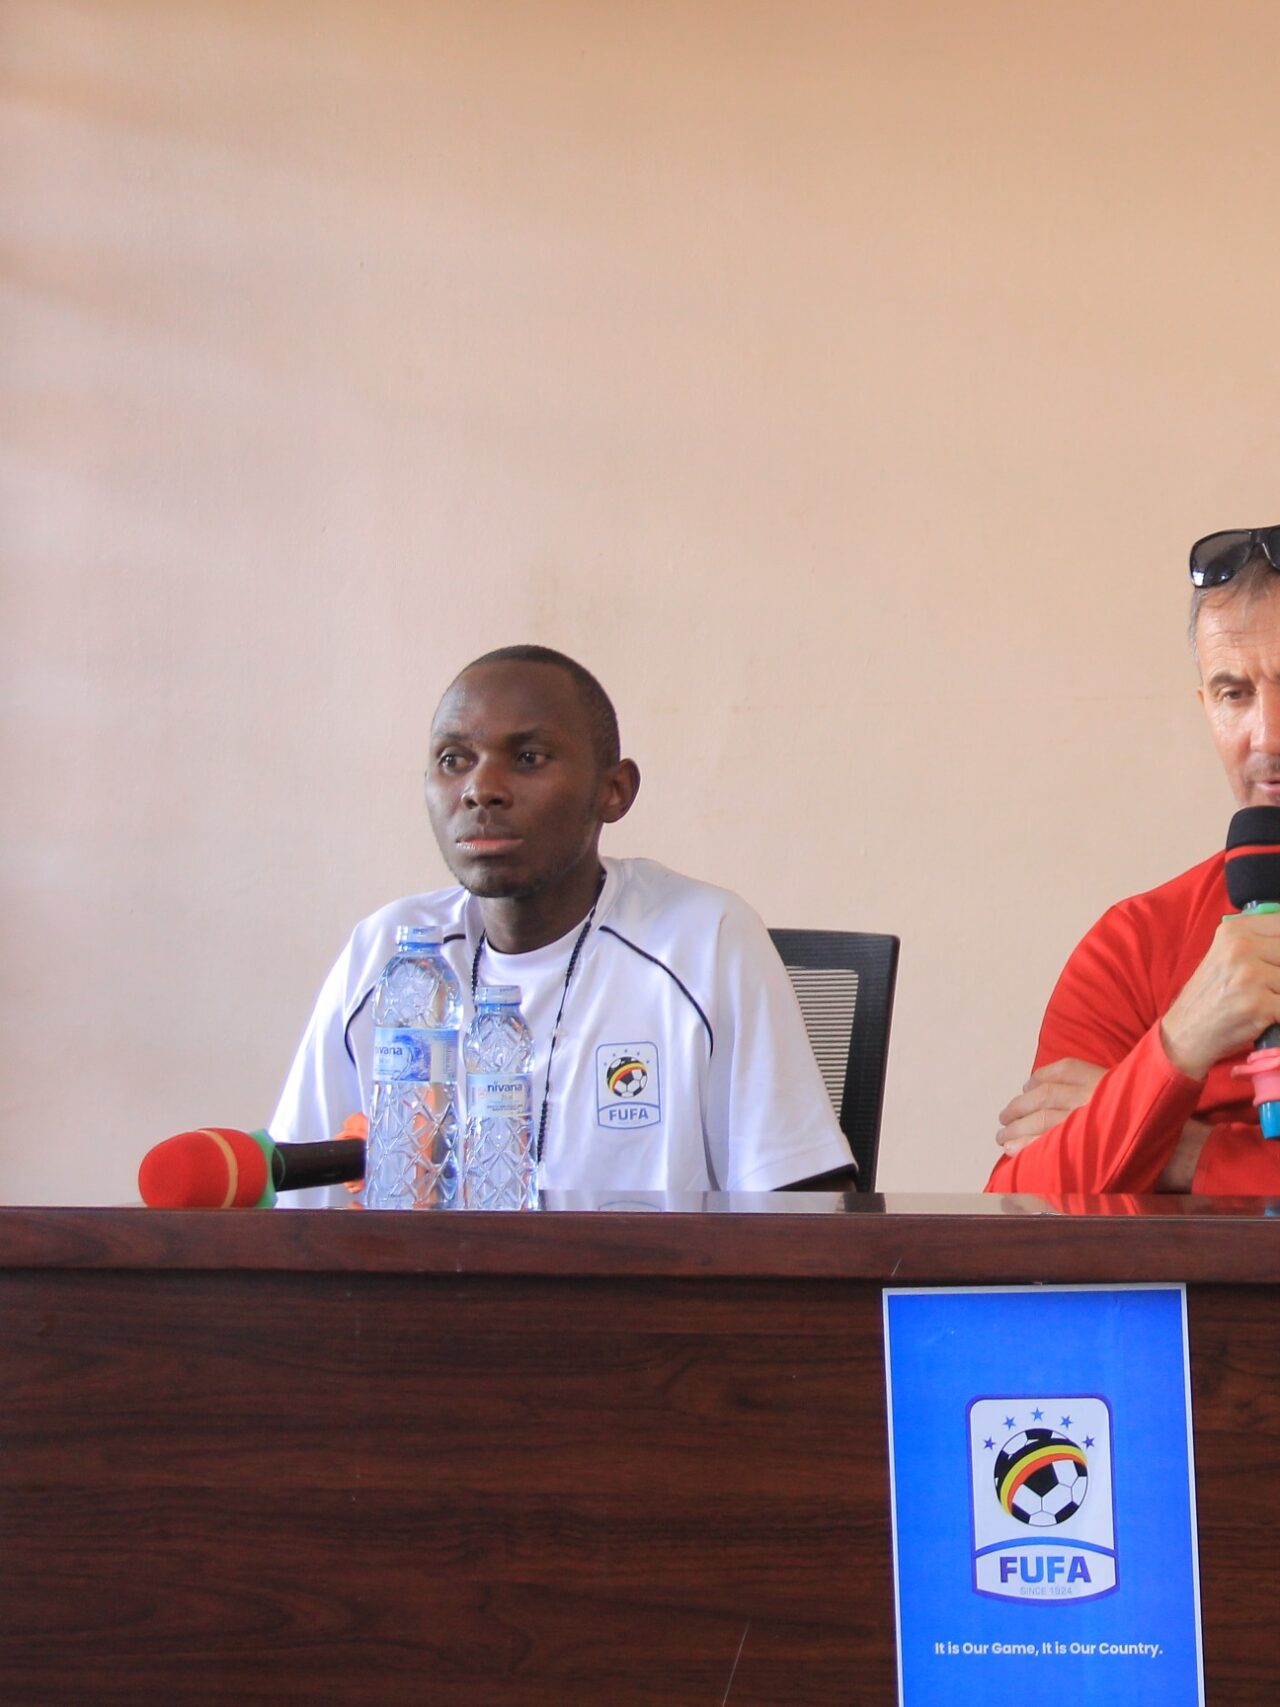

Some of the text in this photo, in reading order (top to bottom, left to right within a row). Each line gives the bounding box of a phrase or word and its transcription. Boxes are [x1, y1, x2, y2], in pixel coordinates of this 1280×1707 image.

[487, 1080, 523, 1092] nivana
[608, 1108, 649, 1121] FUFA
[999, 1556, 1092, 1584] FUFA
[1020, 1586, 1047, 1596] SINCE
[935, 1641, 1164, 1659] It is Our Game, It is Our Country.
